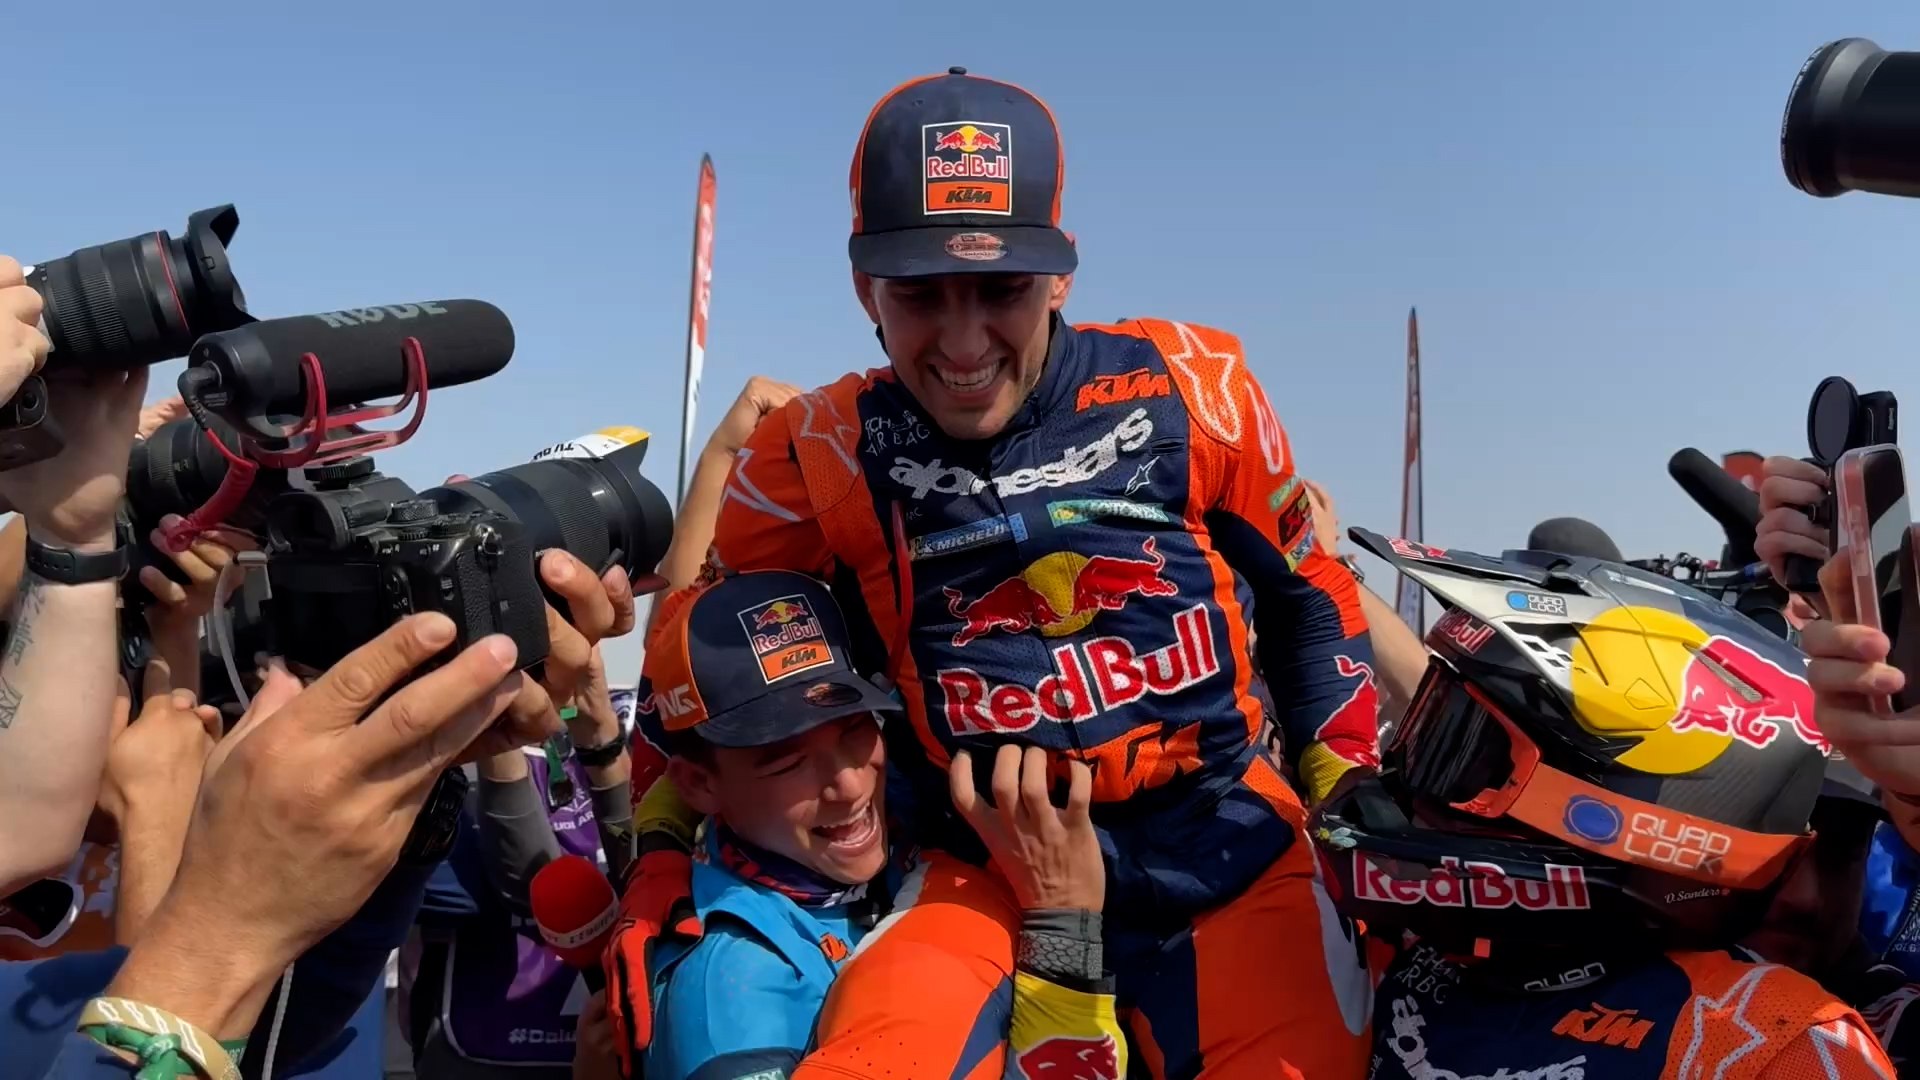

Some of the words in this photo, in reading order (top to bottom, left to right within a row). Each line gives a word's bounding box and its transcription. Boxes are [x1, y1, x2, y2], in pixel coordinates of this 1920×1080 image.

[927, 153, 969, 178] Red
[969, 154, 1008, 179] Bull
[945, 186, 992, 204] KTM
[1076, 368, 1170, 412] KTM
[1527, 593, 1563, 606] QUAD
[1529, 602, 1565, 615] LOCK
[752, 623, 793, 653] Red
[789, 617, 821, 641] Bull
[781, 646, 817, 669] KTM
[937, 643, 1098, 736] Red
[1082, 603, 1220, 712] Bull
[1632, 812, 1732, 855] QUAD
[1624, 833, 1723, 874] LOCK
[1352, 848, 1465, 907] Red
[1464, 861, 1591, 911] Bull
[1552, 1001, 1655, 1049] KTM
